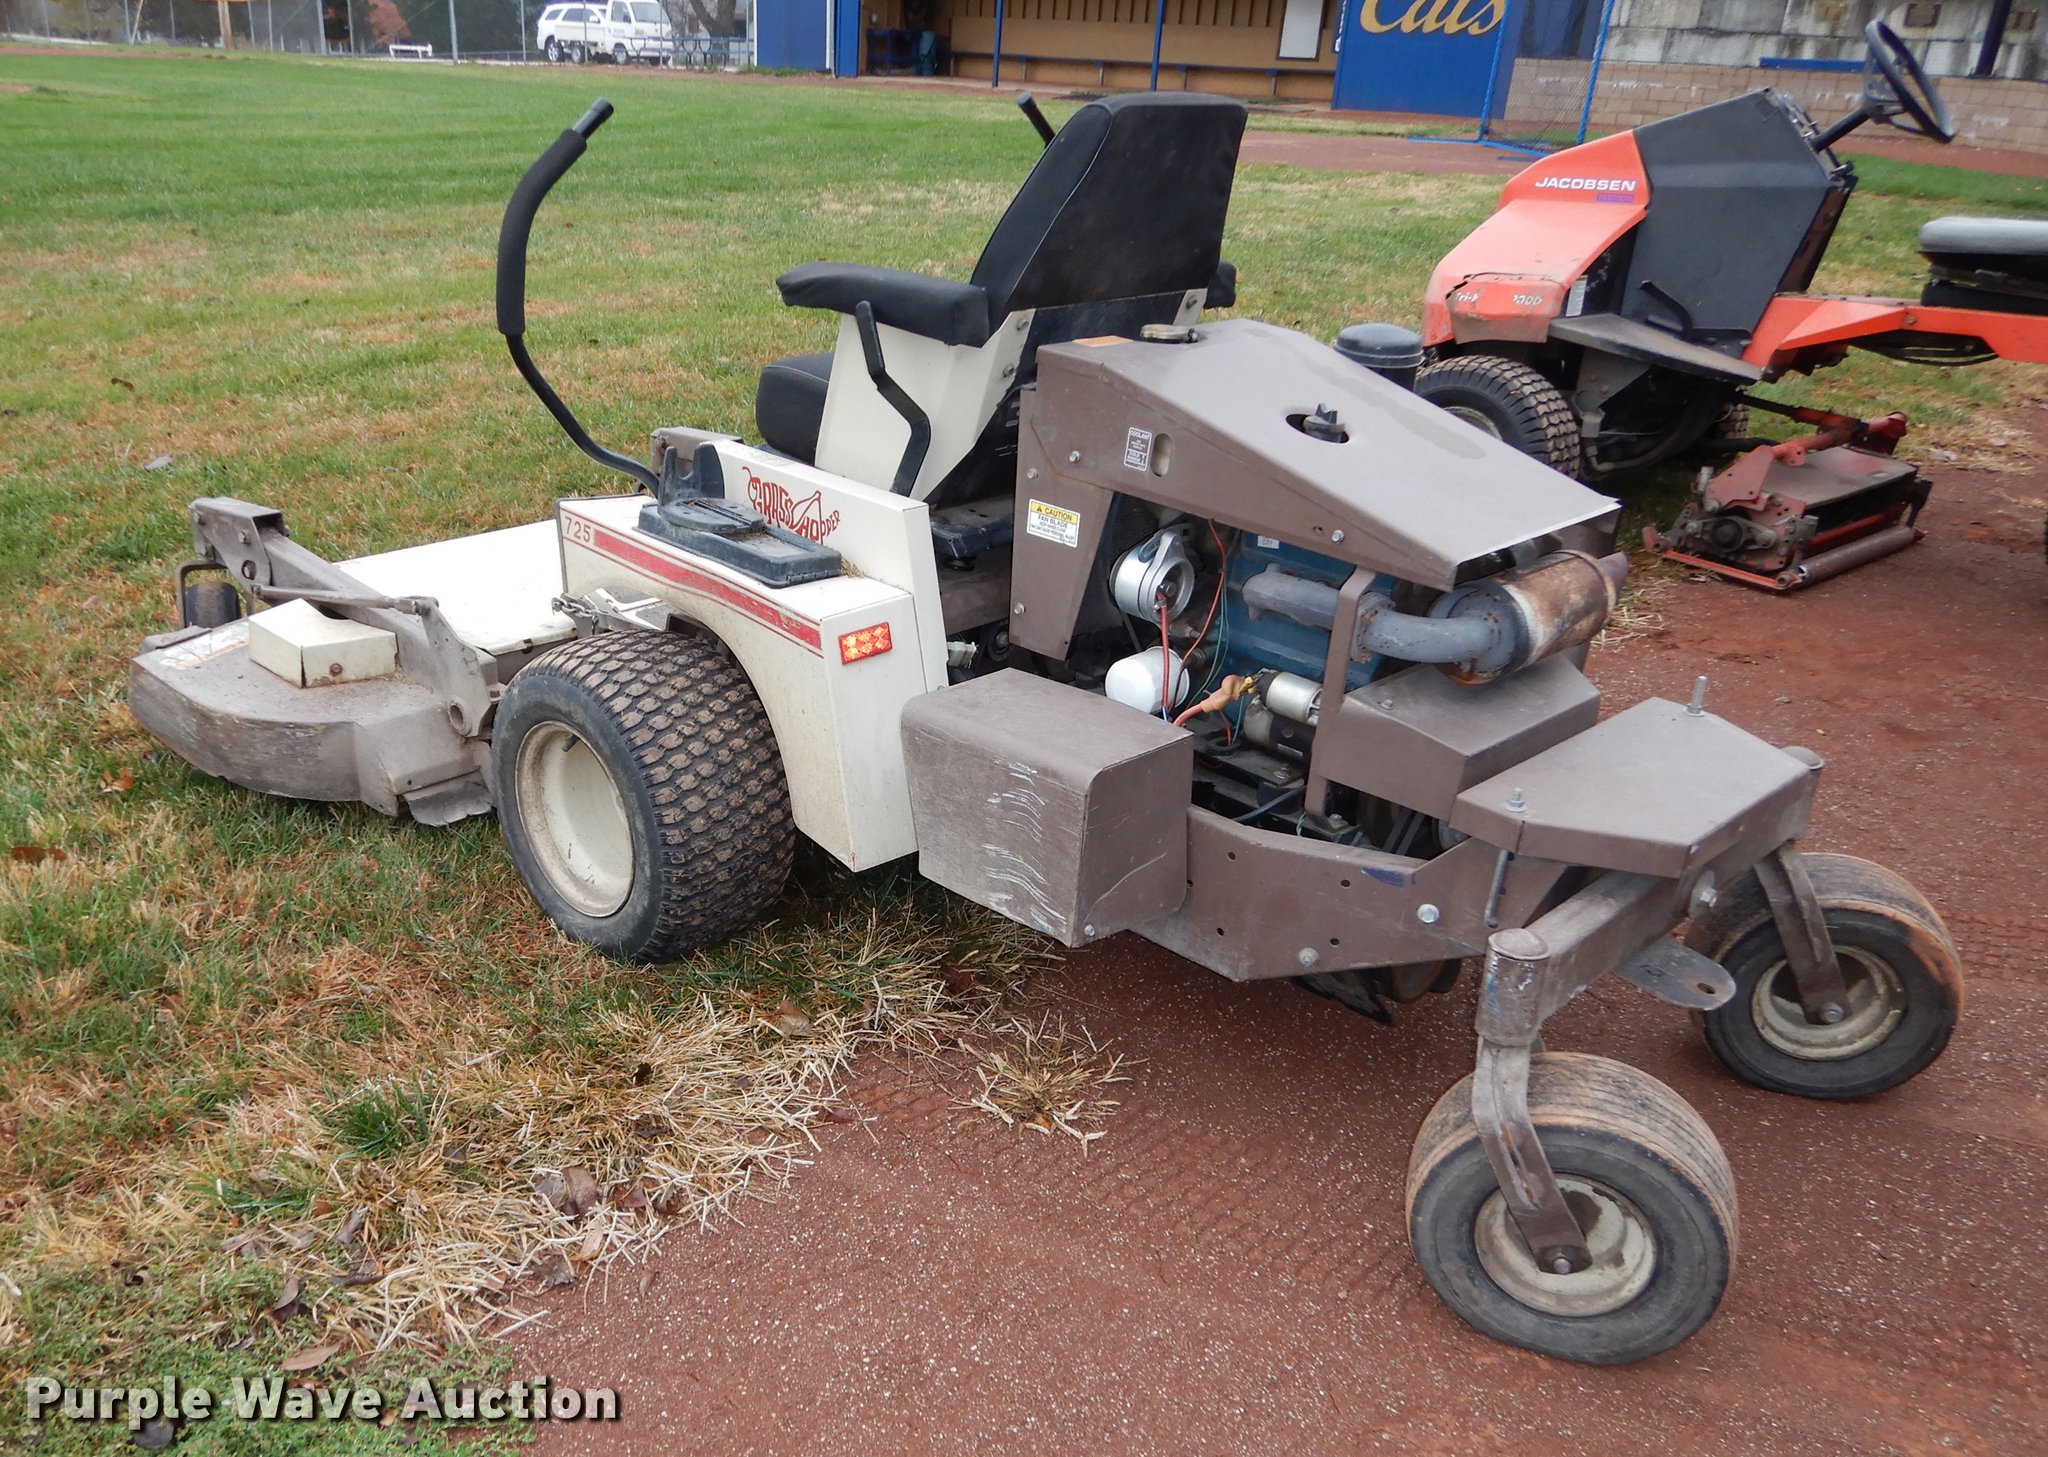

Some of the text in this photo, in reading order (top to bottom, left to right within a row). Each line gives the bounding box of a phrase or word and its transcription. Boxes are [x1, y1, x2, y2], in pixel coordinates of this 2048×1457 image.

[1535, 177, 1636, 191] JACOBSEN
[1045, 507, 1072, 521] CAUTION
[565, 516, 591, 542] 725
